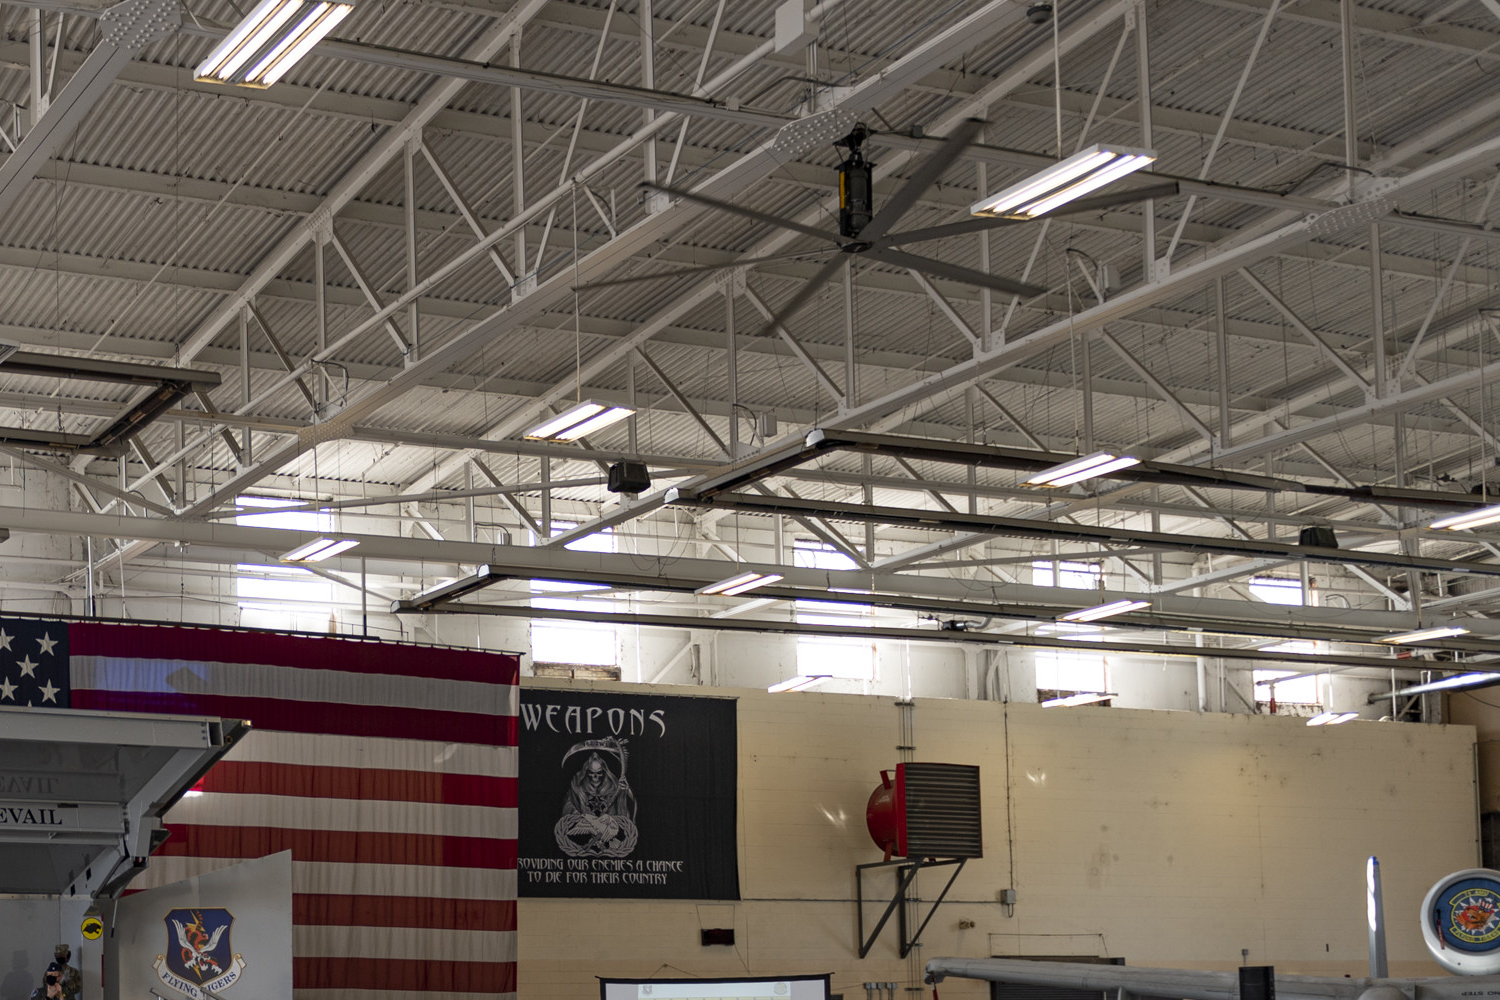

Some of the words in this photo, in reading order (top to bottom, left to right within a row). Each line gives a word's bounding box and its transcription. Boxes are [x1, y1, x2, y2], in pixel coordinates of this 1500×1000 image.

[520, 703, 666, 738] WEAPONS
[517, 857, 564, 870] ROVIDING
[567, 859, 589, 871] OUR
[592, 859, 633, 871] ENEMIES
[636, 860, 643, 872] A
[646, 860, 684, 873] CHANCE
[527, 871, 541, 883] TO
[545, 871, 562, 883] DIE
[566, 871, 588, 884] FOR
[591, 872, 620, 884] THEIR
[622, 872, 667, 885] COUNTRY
[162, 972, 198, 997] FLYING
